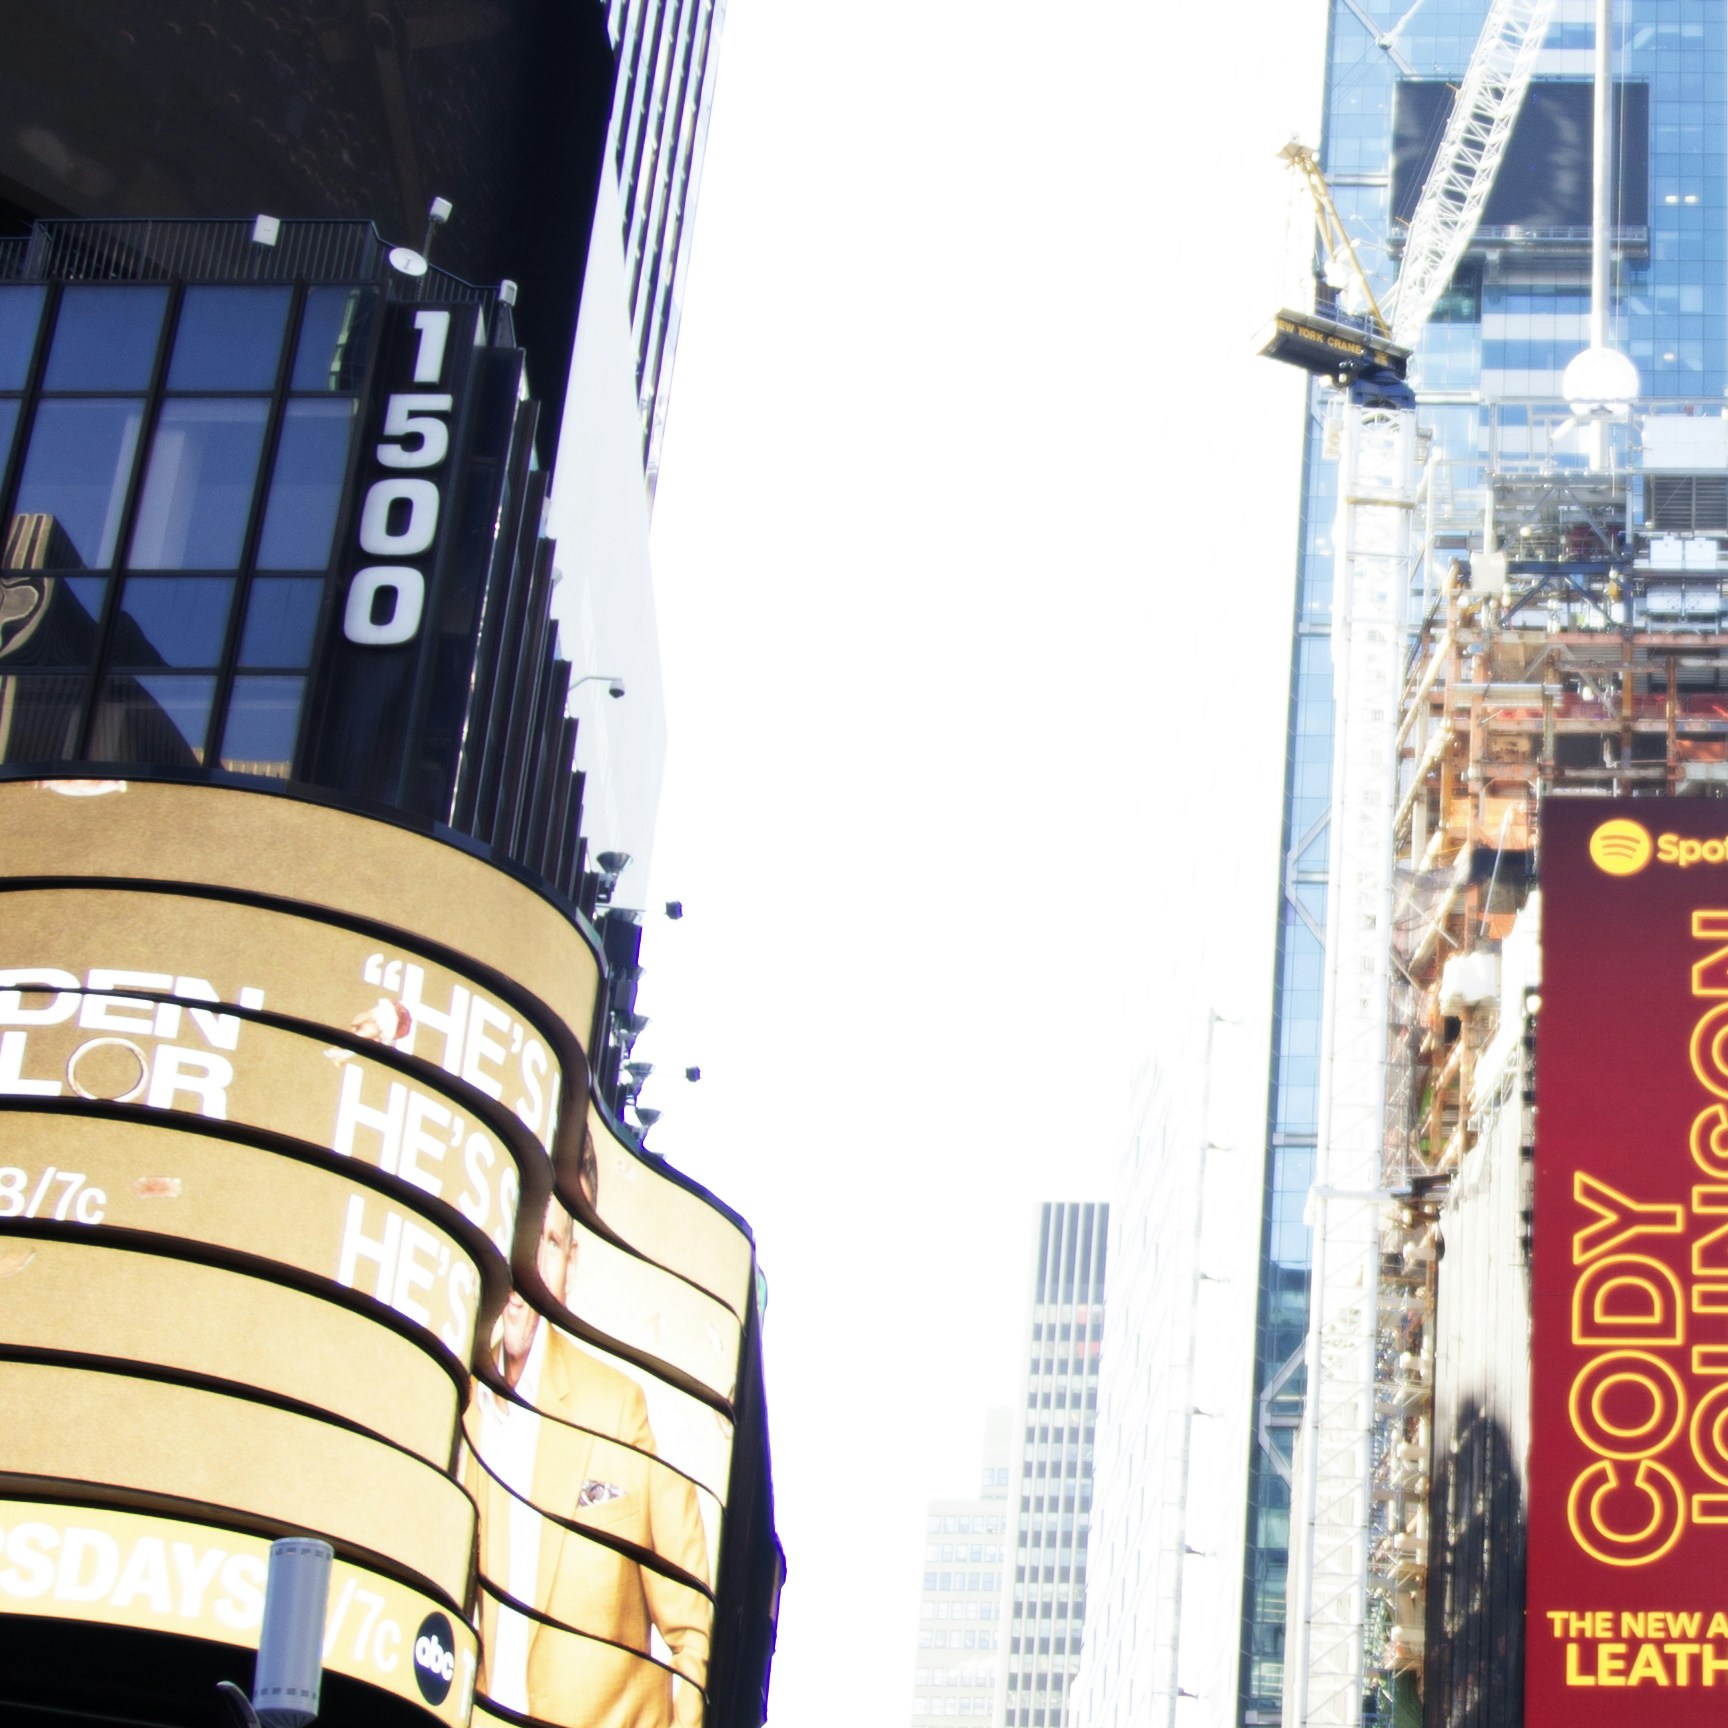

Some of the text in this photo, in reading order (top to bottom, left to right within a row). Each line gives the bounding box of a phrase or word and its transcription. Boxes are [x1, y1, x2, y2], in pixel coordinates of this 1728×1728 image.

[343, 310, 453, 645] 1500
[1567, 1171, 1685, 1569] CODY
[0, 1522, 268, 1629] SDAYS
[1546, 1611, 1613, 1638] THE
[1620, 1611, 1701, 1638] NEW
